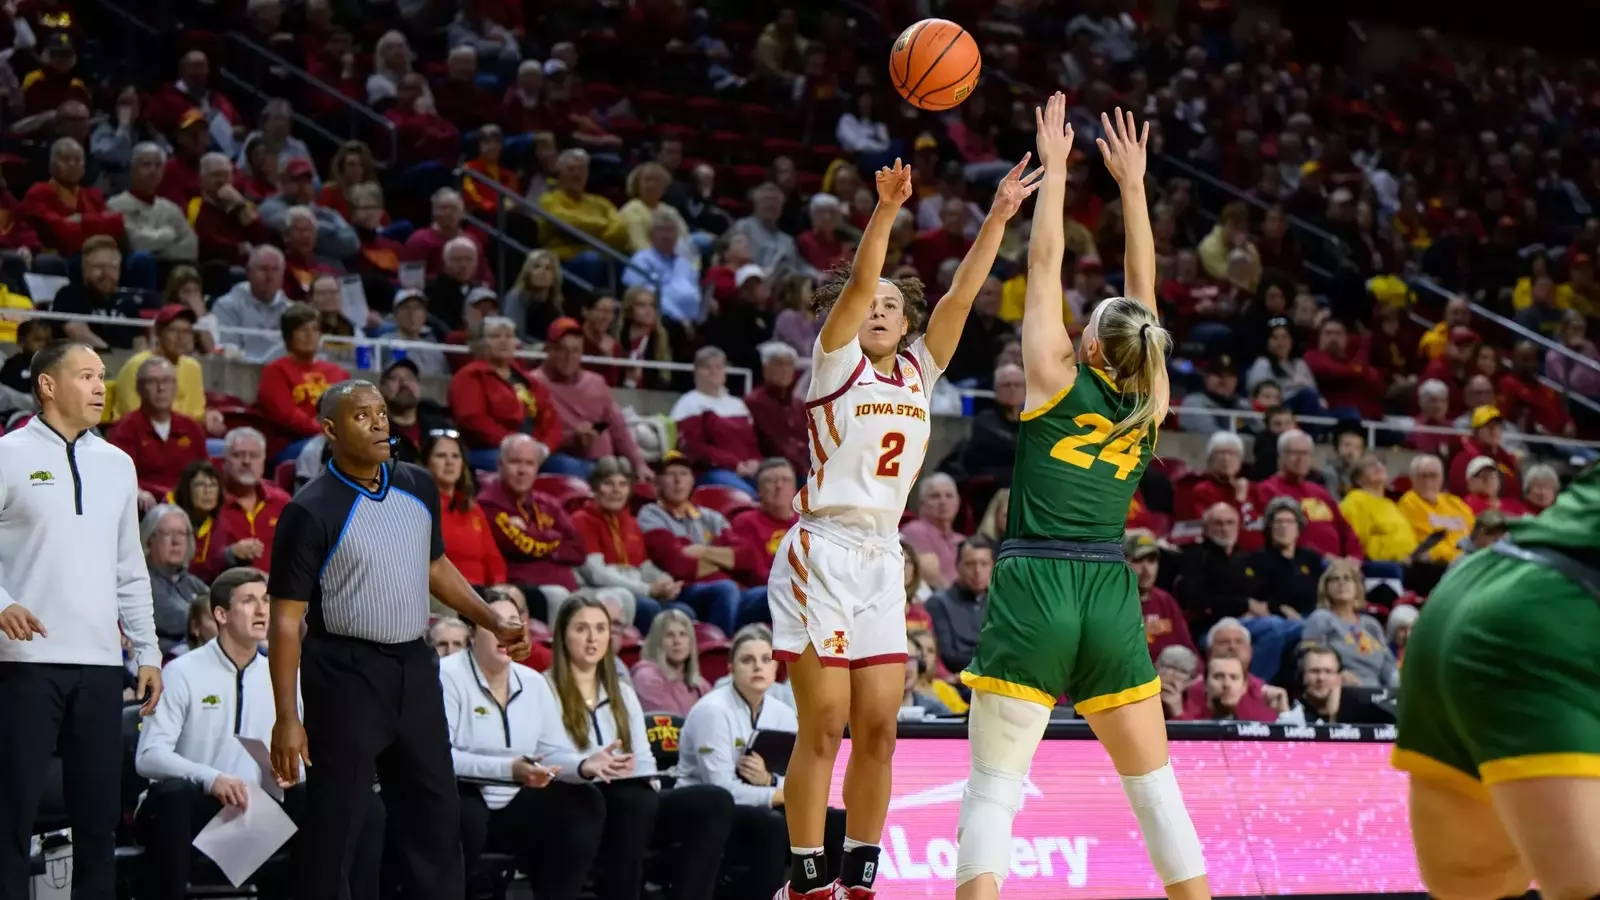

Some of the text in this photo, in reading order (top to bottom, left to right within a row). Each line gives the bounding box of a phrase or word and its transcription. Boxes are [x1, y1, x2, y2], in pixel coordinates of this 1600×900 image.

[855, 403, 926, 422] IOWA STATE
[876, 430, 906, 477] 2
[1050, 412, 1145, 481] 24
[648, 726, 680, 743] STAT
